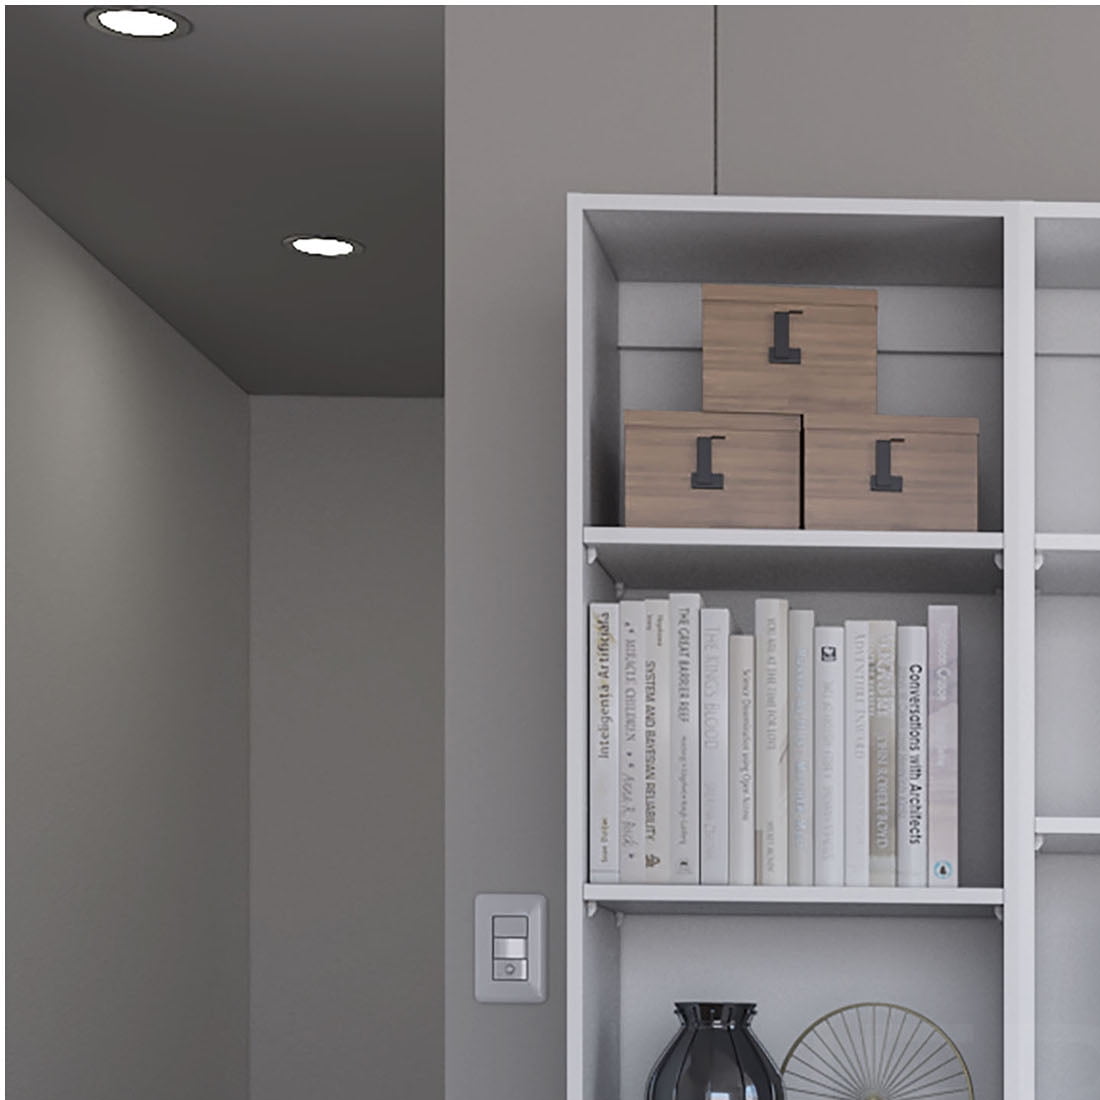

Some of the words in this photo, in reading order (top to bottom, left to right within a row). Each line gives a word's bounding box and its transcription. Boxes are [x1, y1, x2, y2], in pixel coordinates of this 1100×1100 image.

[678, 608, 690, 625] THE
[678, 627, 690, 658] GREAT
[645, 660, 656, 703] SYSTEM
[678, 659, 690, 699] BARRIER
[742, 669, 750, 697] Science
[645, 705, 656, 728] AND
[678, 701, 690, 723] REEF
[909, 664, 922, 751] Conversations
[704, 703, 719, 750] BLOOD
[645, 730, 656, 780] BAYESIAN
[909, 754, 922, 780] with
[740, 774, 750, 794] Open
[645, 782, 656, 842] RELIABILITY
[909, 784, 922, 844] Architects
[876, 814, 888, 849] BOYD
